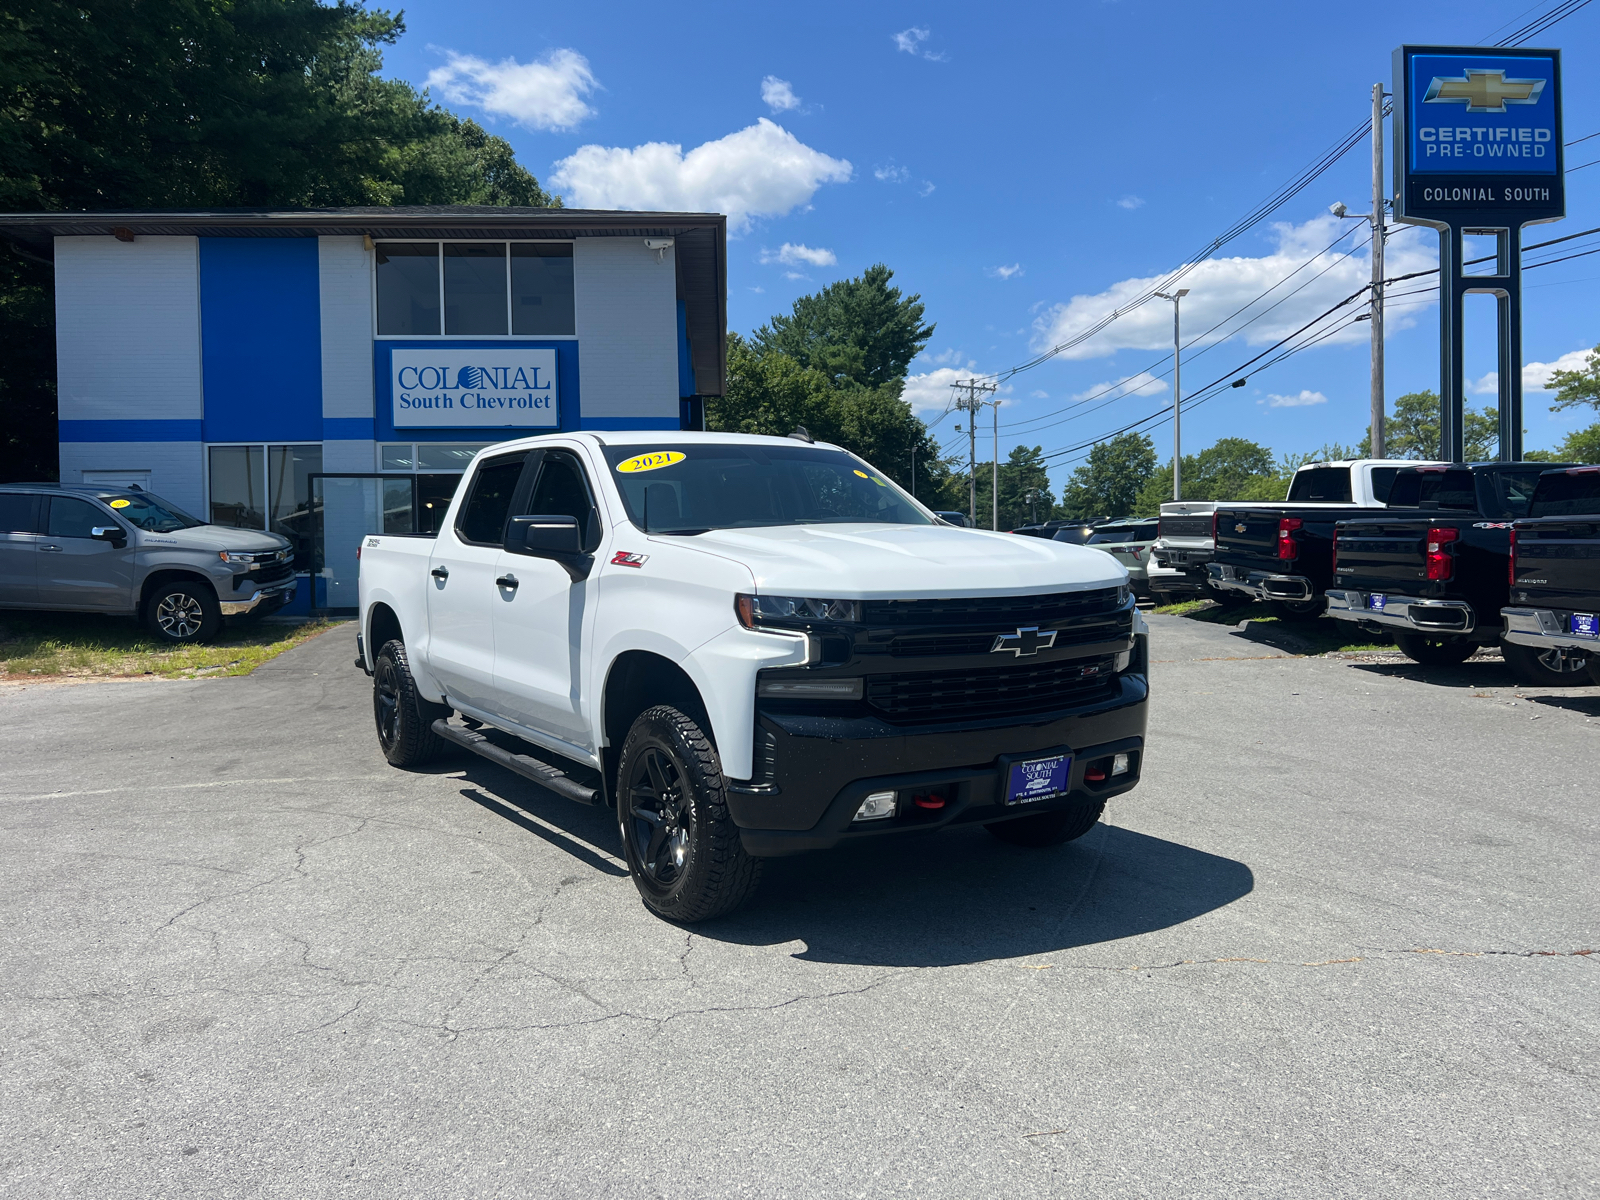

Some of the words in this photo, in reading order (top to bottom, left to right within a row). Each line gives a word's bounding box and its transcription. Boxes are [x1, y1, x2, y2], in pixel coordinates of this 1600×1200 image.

[1419, 127, 1551, 142] CERTIFIED
[1427, 144, 1545, 157] PRE-OWNED
[1424, 188, 1495, 201] COLONIAL
[1504, 188, 1550, 201] SOUTH
[398, 365, 551, 390] COLONIAL
[400, 392, 453, 409] South
[460, 392, 551, 409] Chevrolet
[631, 453, 671, 470] 2021
[610, 551, 650, 568] Z71
[1021, 761, 1059, 774] COLONIAL
[1025, 769, 1052, 781] SOUTH
[1020, 796, 1041, 804] COLONIAL
[1041, 793, 1056, 801] SOUTH
